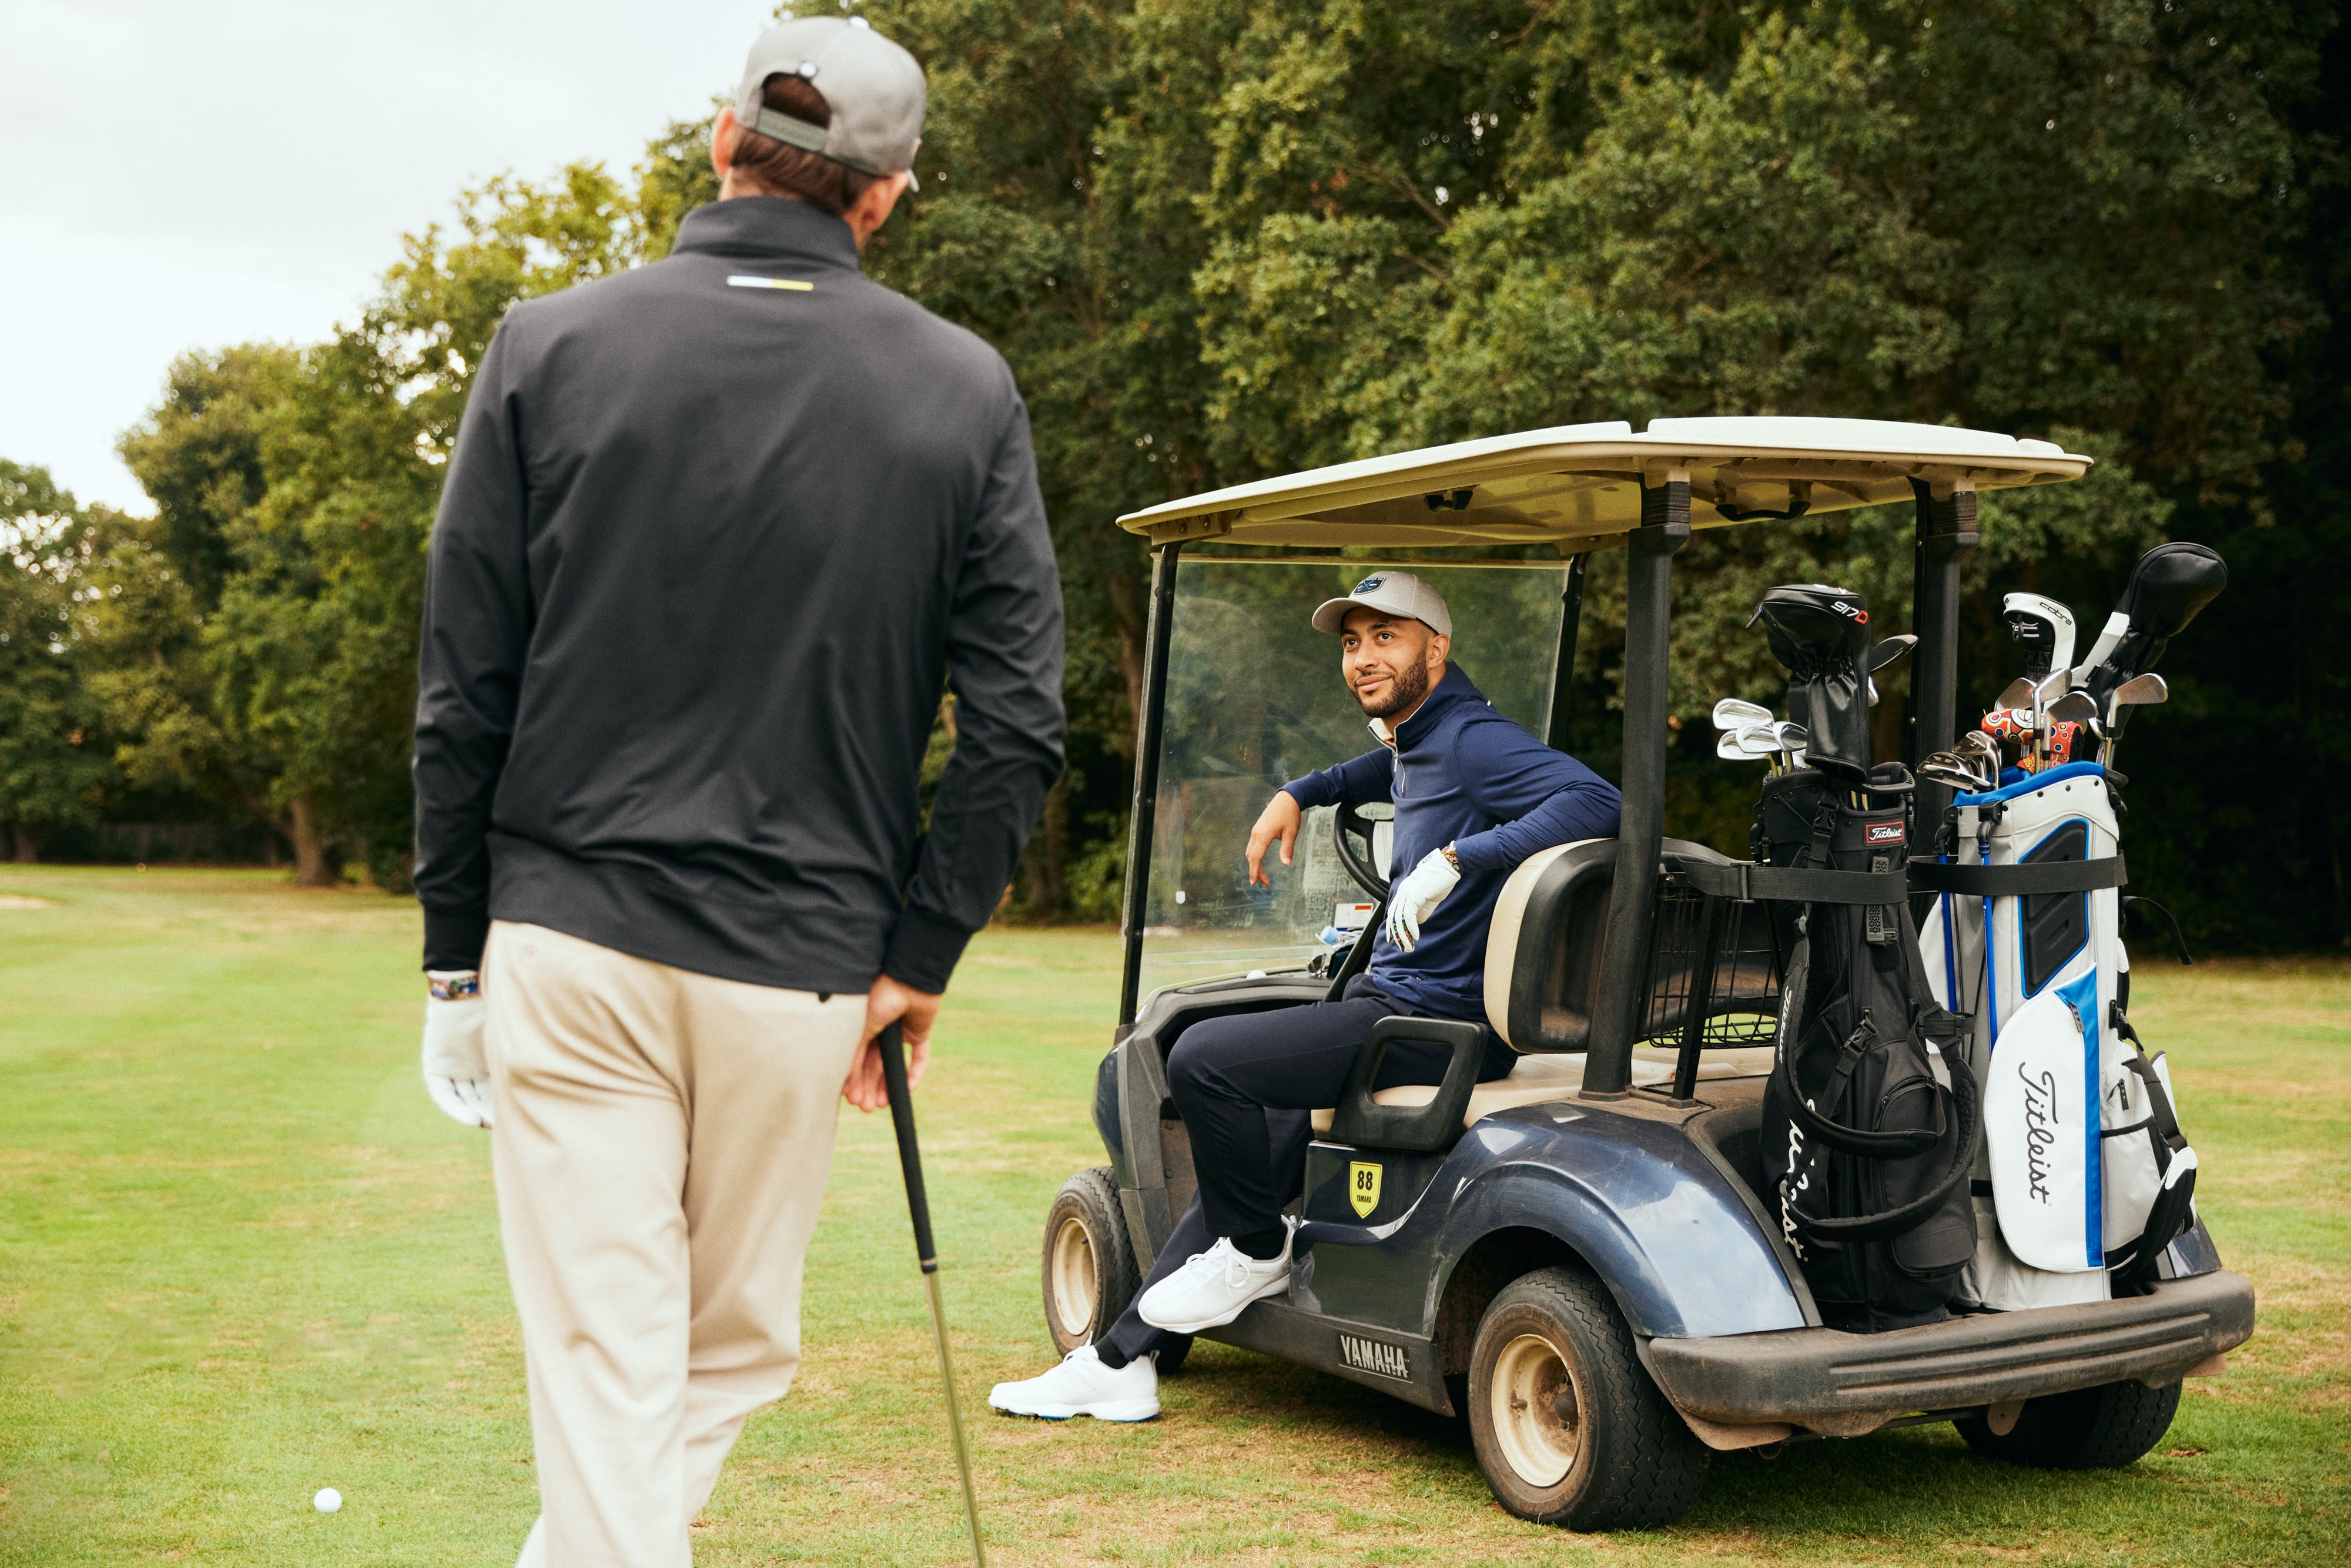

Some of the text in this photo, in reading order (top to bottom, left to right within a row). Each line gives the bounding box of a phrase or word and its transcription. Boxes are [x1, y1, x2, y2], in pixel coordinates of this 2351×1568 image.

[1830, 601, 1868, 624] 917D
[2039, 602, 2072, 625] cobra
[1869, 826, 1902, 840] Titleist
[2018, 1061, 2058, 1204] Titleist
[1357, 1170, 1373, 1191] 88
[1357, 1195, 1371, 1204] YAMAHA
[1340, 1335, 1408, 1378] YAMAHA
